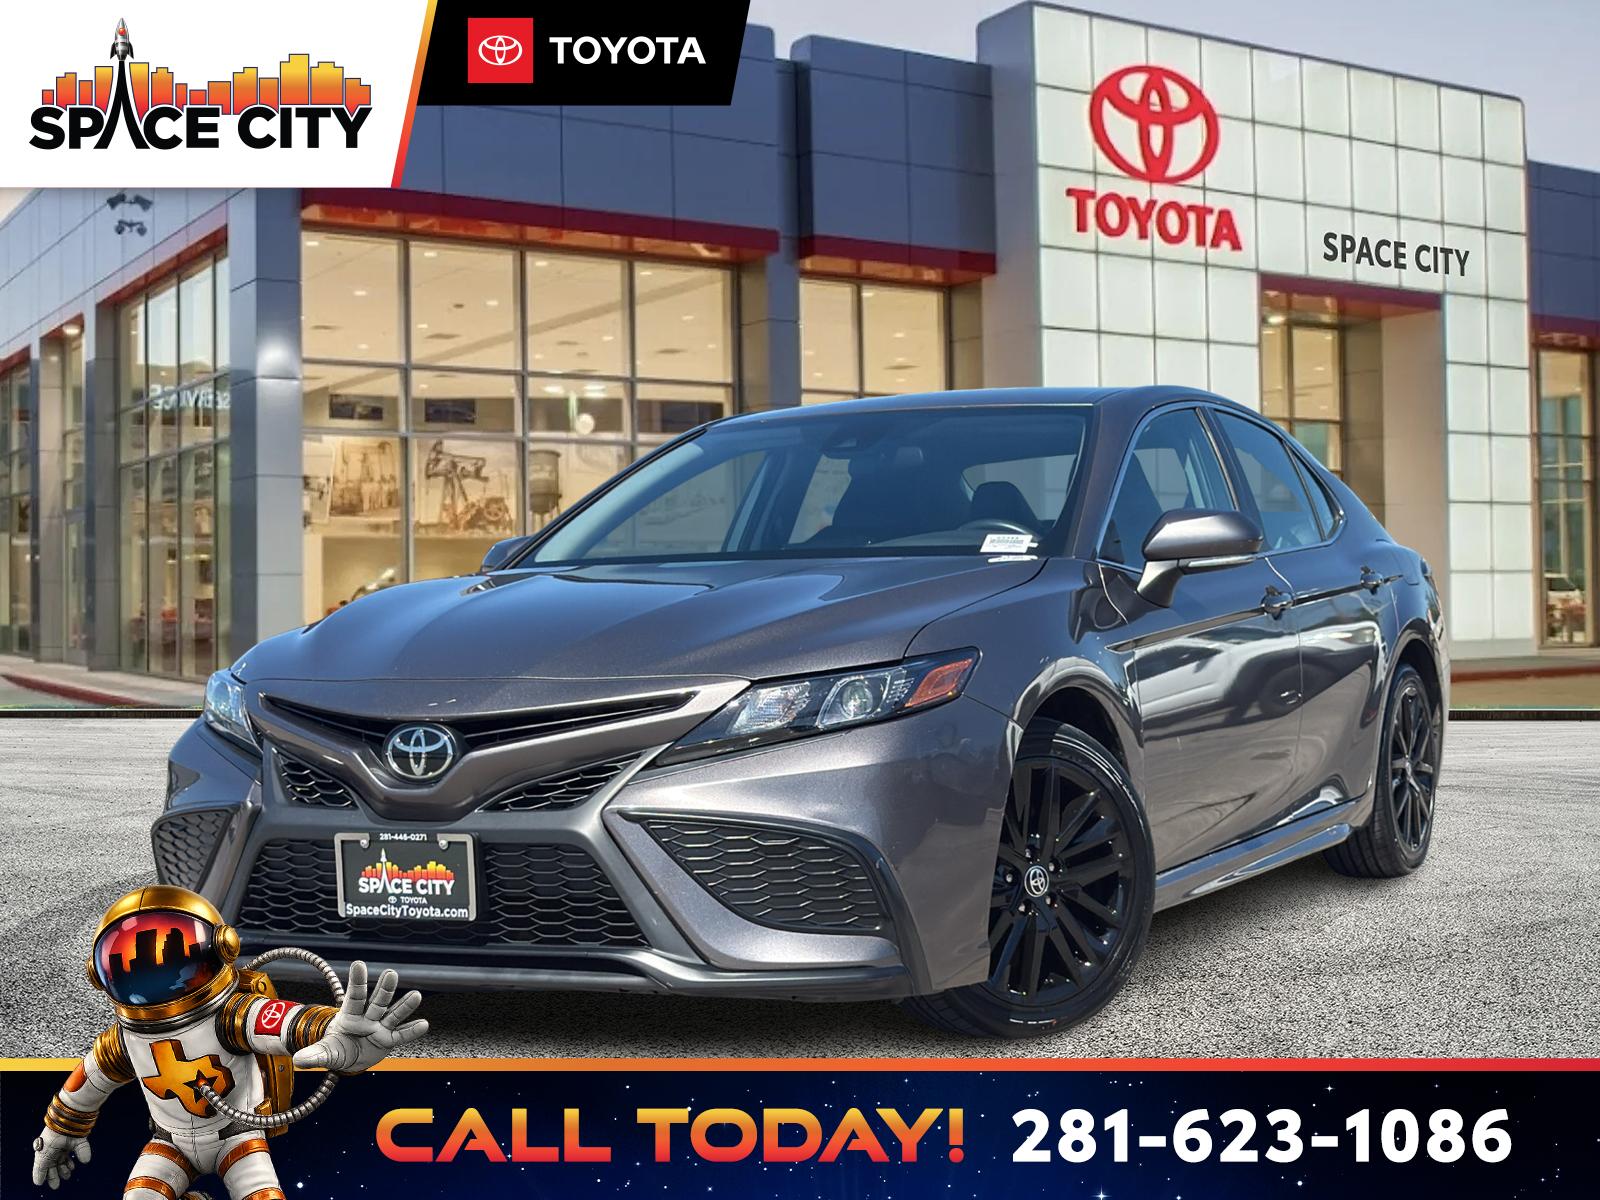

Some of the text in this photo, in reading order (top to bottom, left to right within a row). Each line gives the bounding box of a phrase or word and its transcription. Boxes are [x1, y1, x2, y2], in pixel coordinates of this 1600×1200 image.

[1066, 187, 1242, 251] TOYOTA
[1322, 231, 1471, 277] SPACE CITY
[358, 877, 455, 895] SPACE CITY
[400, 896, 428, 904] TOYOTA
[346, 903, 469, 919] SpaceCityToyota.com
